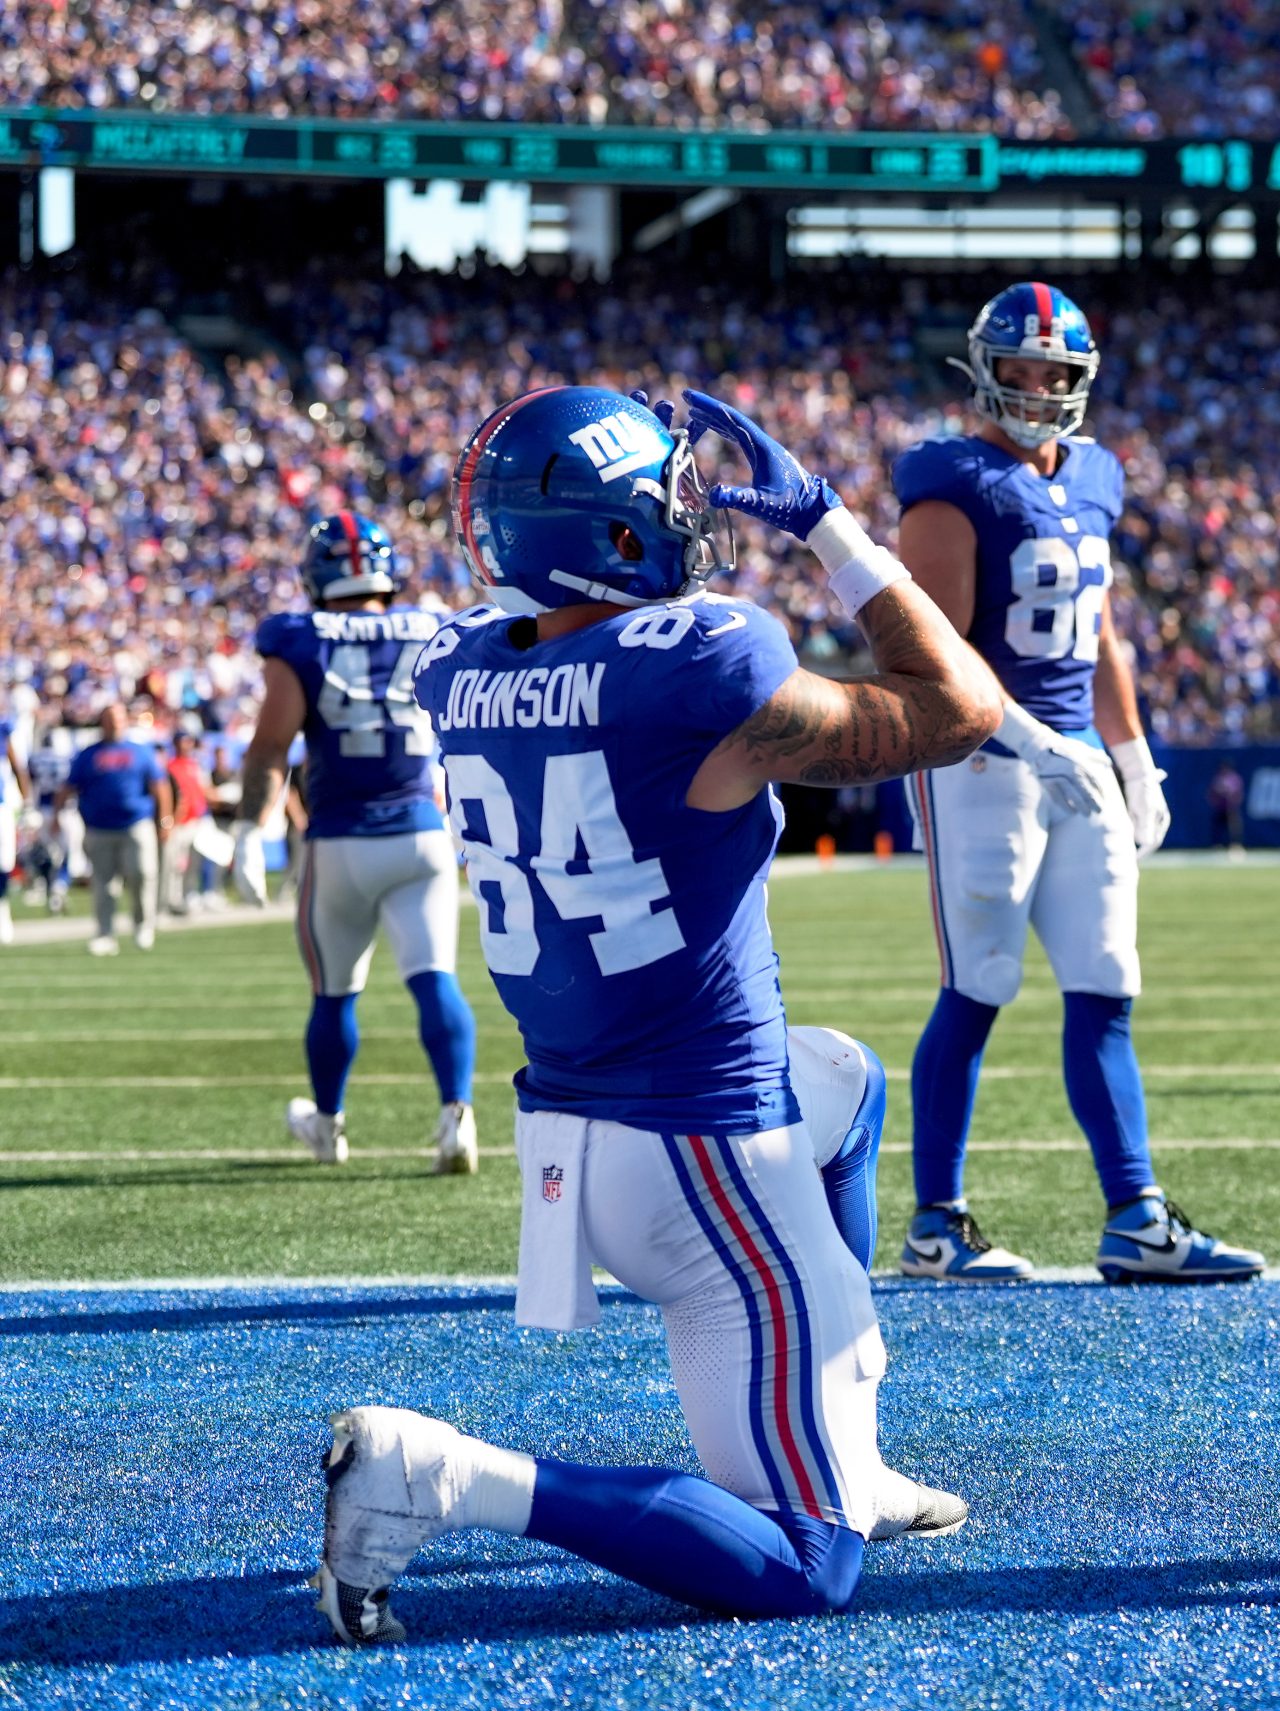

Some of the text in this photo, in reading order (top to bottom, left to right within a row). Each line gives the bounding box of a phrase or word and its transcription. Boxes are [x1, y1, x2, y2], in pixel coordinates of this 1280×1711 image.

[1004, 534, 1114, 663] 82
[317, 645, 434, 758] 44
[438, 662, 606, 731] JOHNSON
[443, 749, 687, 977] 84
[544, 1182, 561, 1200] NFL
